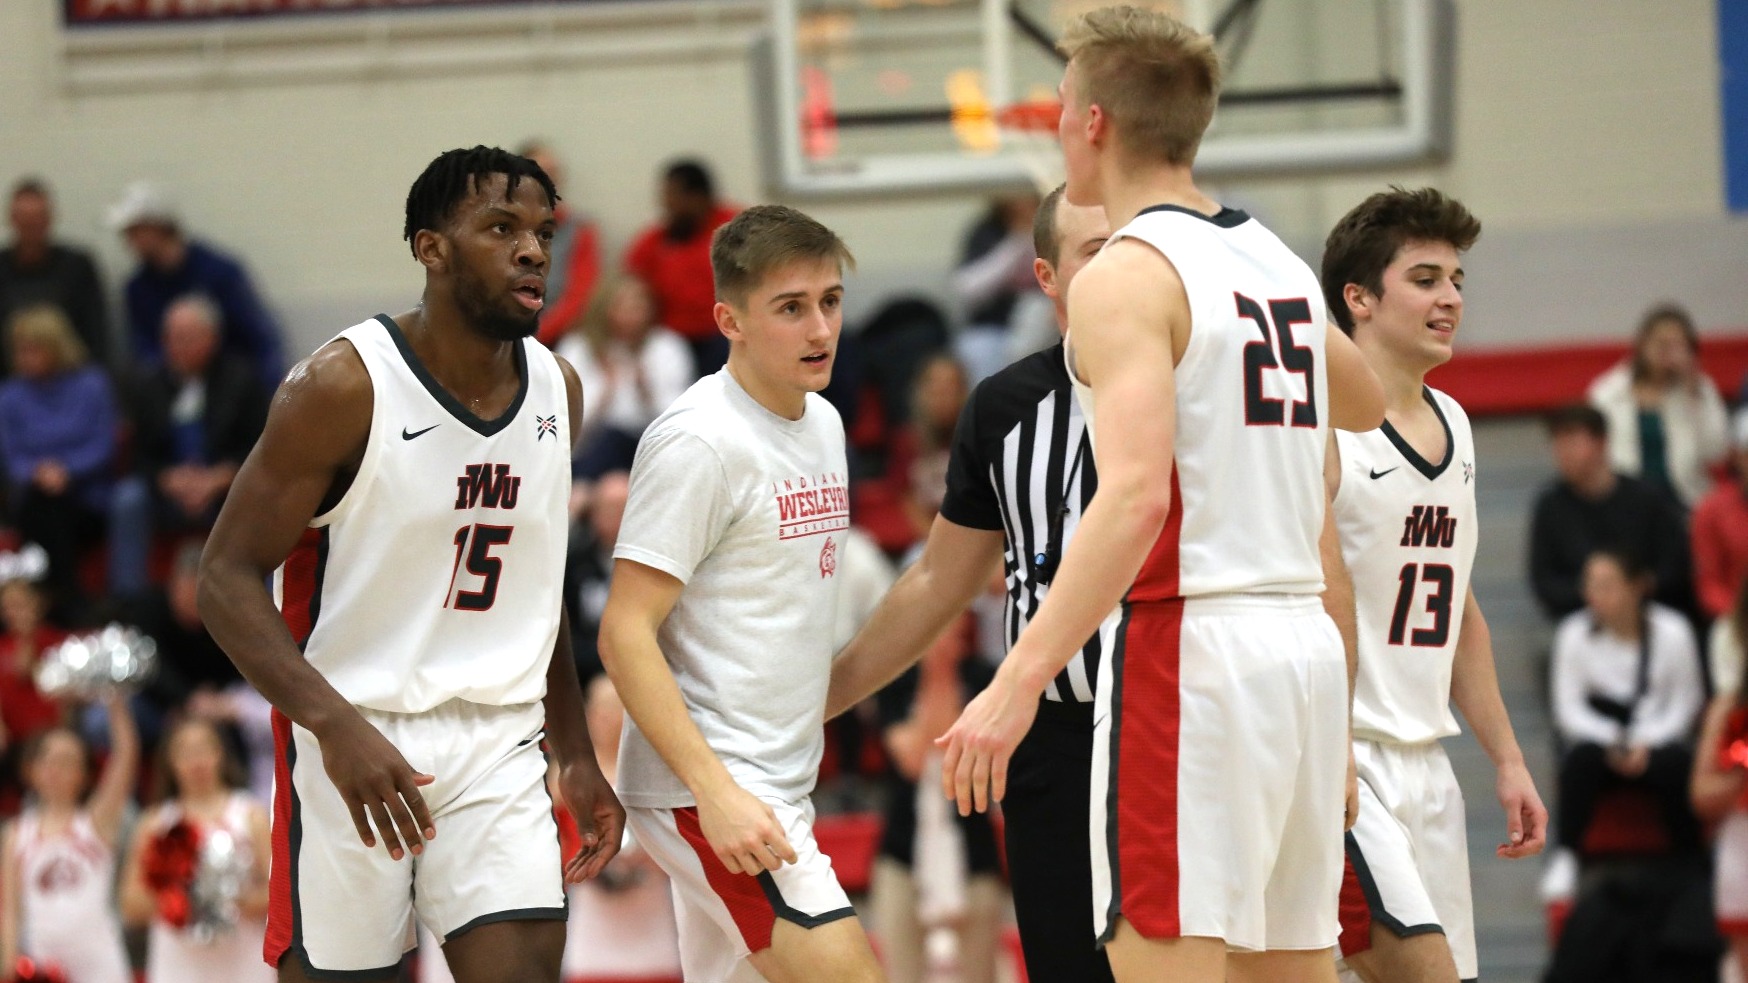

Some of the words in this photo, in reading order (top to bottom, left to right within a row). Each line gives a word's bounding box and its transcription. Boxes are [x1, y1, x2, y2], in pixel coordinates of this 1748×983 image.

[1233, 291, 1318, 429] 25
[454, 463, 521, 510] IWU
[1400, 505, 1457, 548] IWU
[443, 523, 514, 612] 15
[1388, 562, 1454, 647] 13
